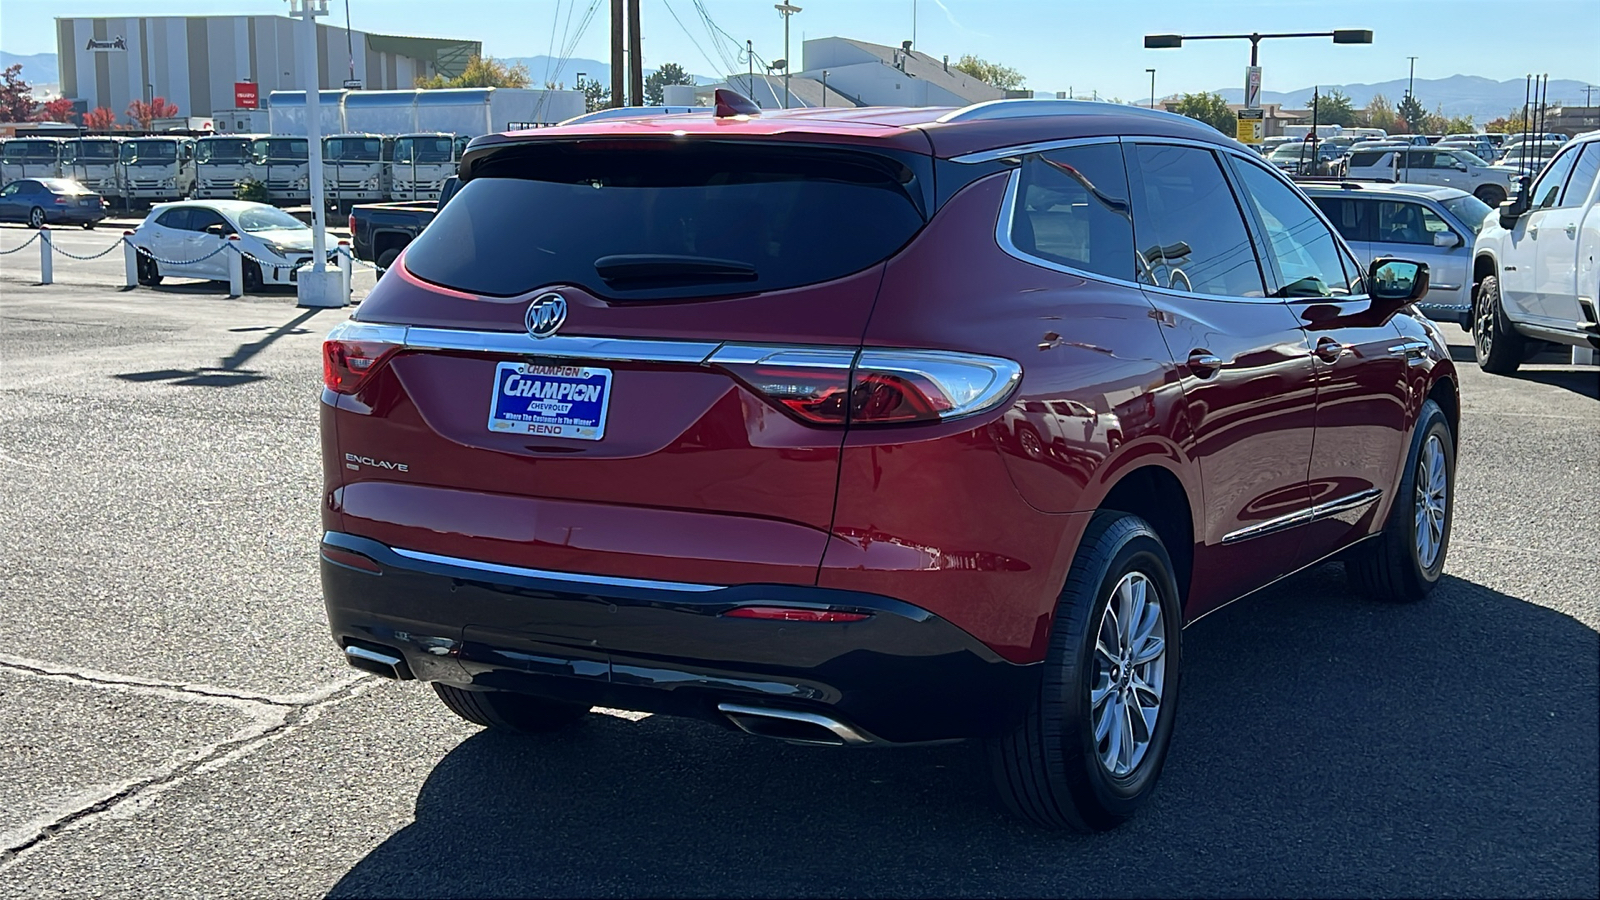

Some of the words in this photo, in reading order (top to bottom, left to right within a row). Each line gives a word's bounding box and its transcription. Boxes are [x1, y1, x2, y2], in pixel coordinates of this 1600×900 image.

[527, 365, 580, 377] CHAMPION
[531, 402, 569, 412] CHEVROLET
[533, 415, 558, 423] Customer
[527, 424, 562, 434] RENO
[345, 453, 409, 472] ENCLAVE
